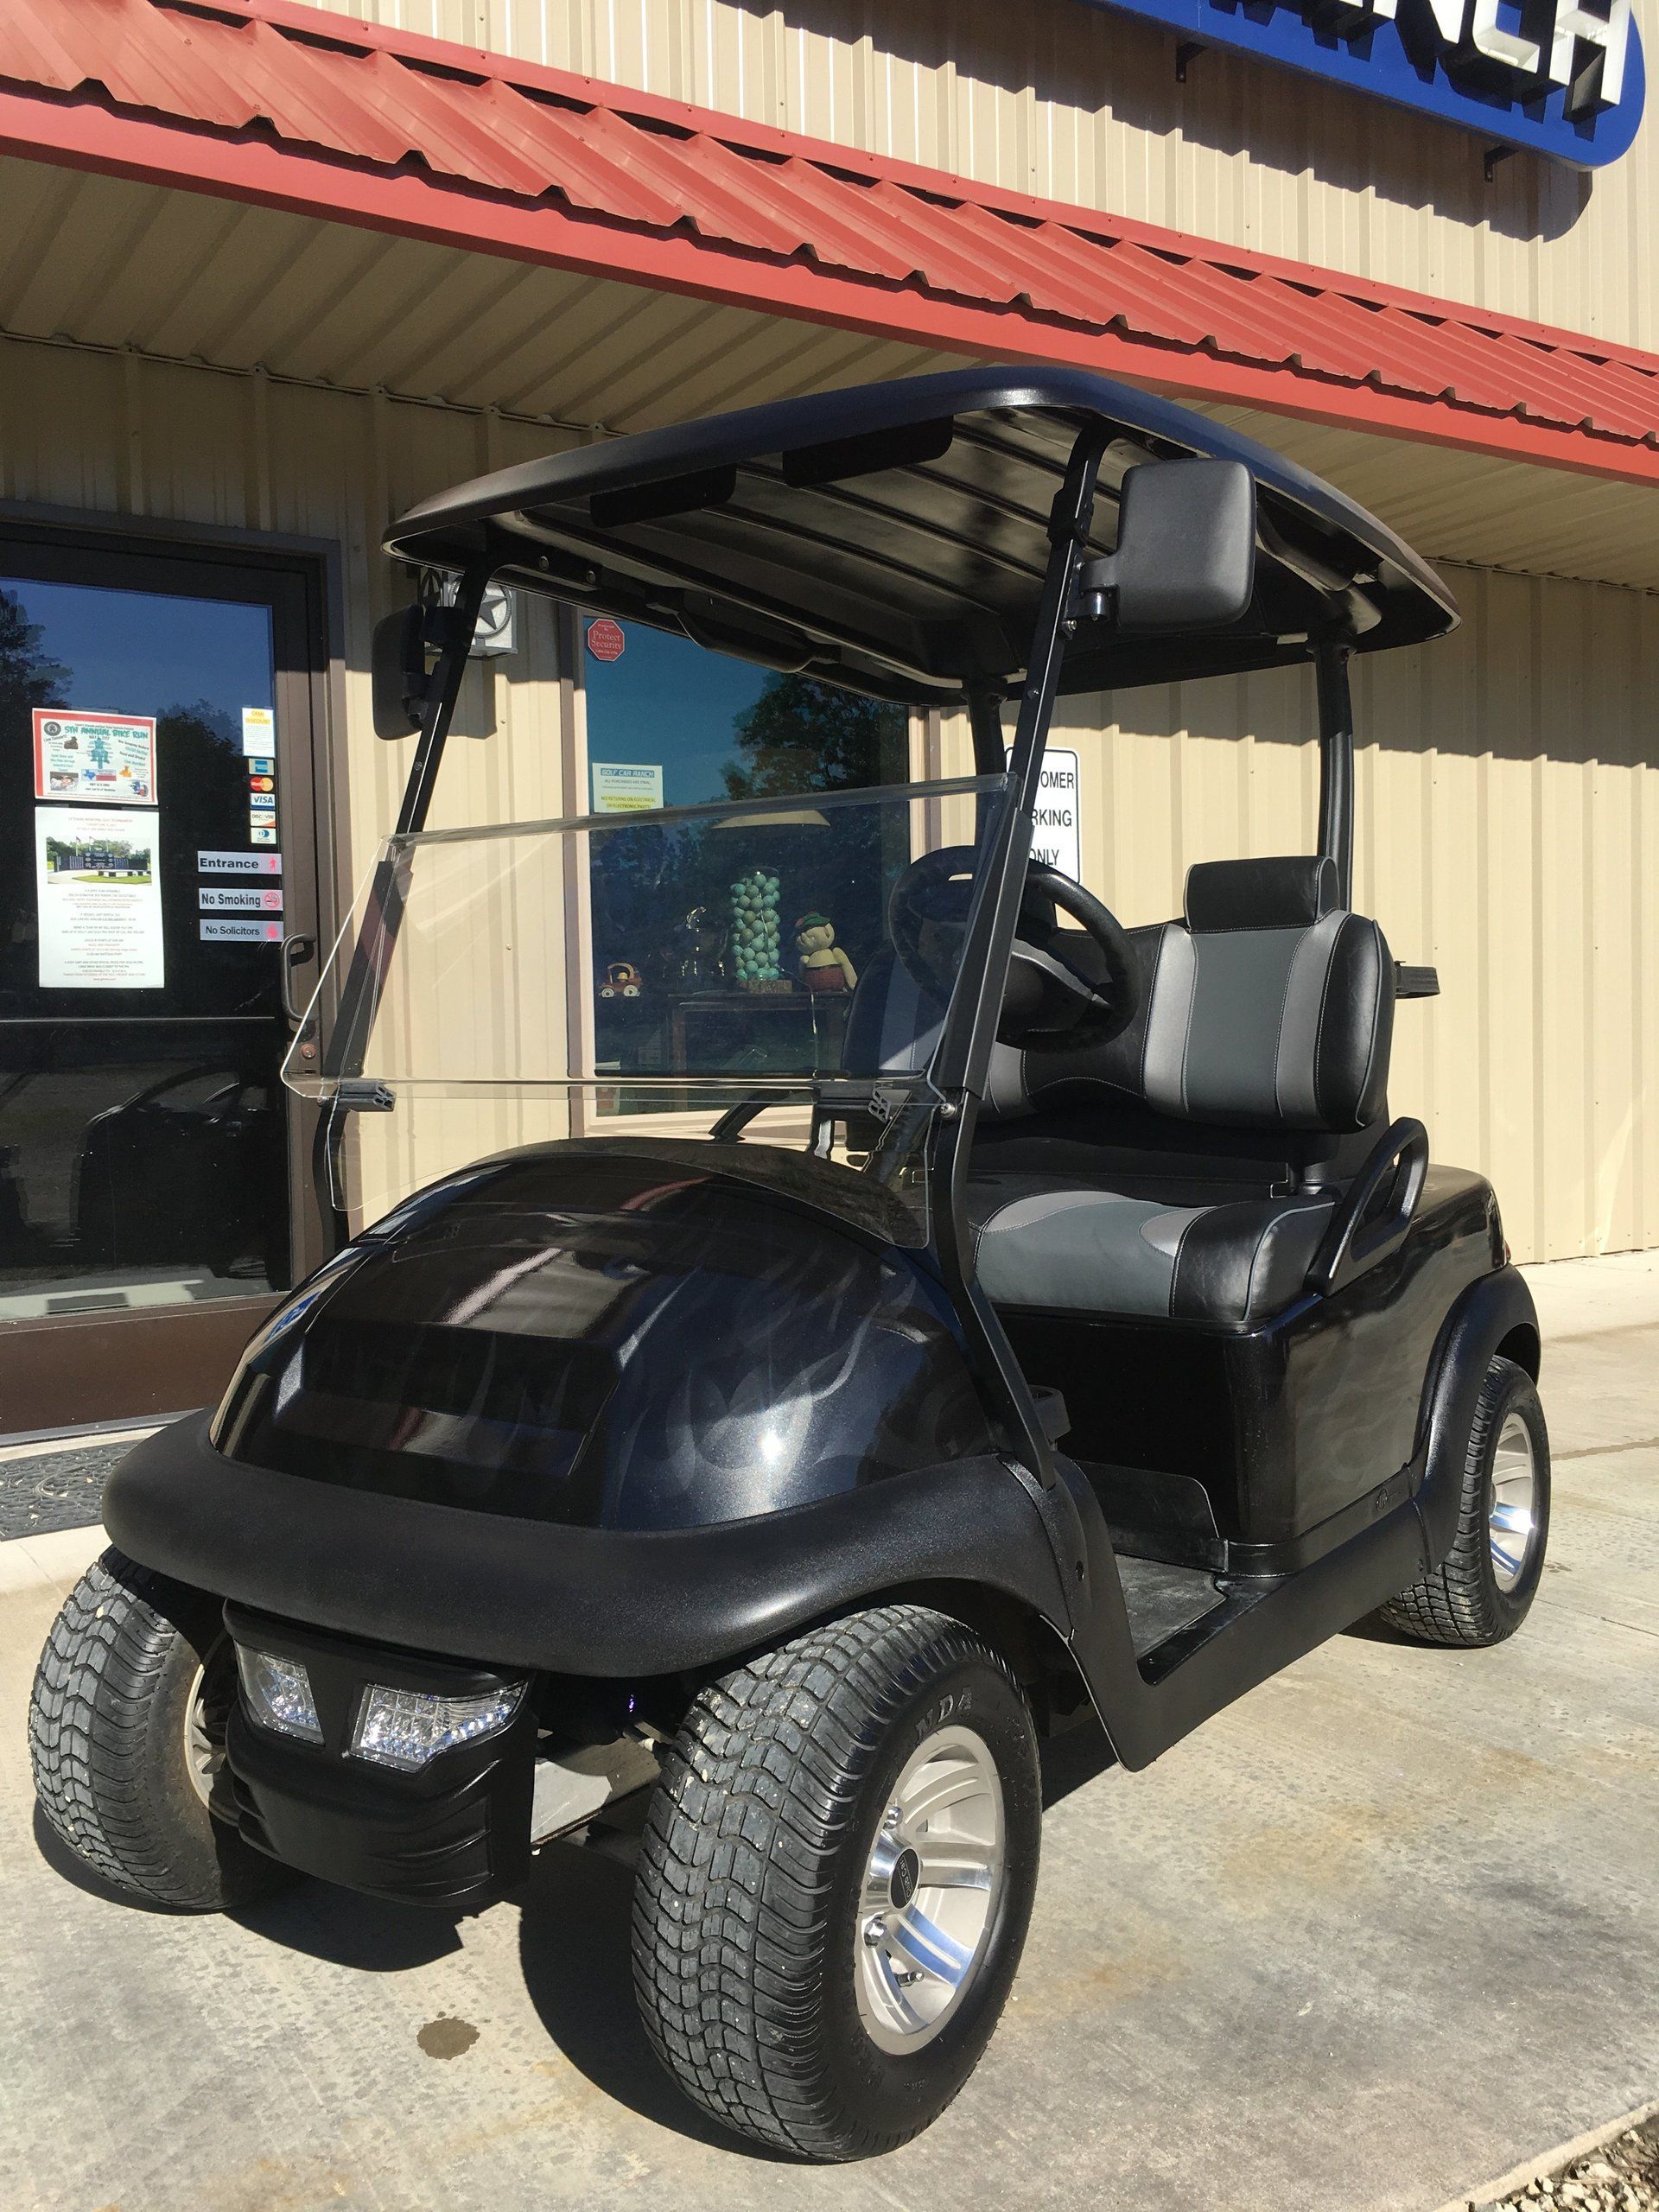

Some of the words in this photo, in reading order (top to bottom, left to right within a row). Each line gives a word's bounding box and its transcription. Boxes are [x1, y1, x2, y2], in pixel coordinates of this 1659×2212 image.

[593, 630, 621, 642] Protect
[591, 639, 622, 650] Security
[80, 727, 111, 736] ANNUAL
[111, 729, 130, 738] BIKE
[1040, 771, 1074, 789] OMER
[1032, 809, 1072, 827] RKING
[200, 858, 259, 868] Entrance
[201, 893, 215, 905] No
[218, 893, 261, 908] Smoking
[206, 926, 218, 935] No
[219, 926, 260, 936] Solicitors
